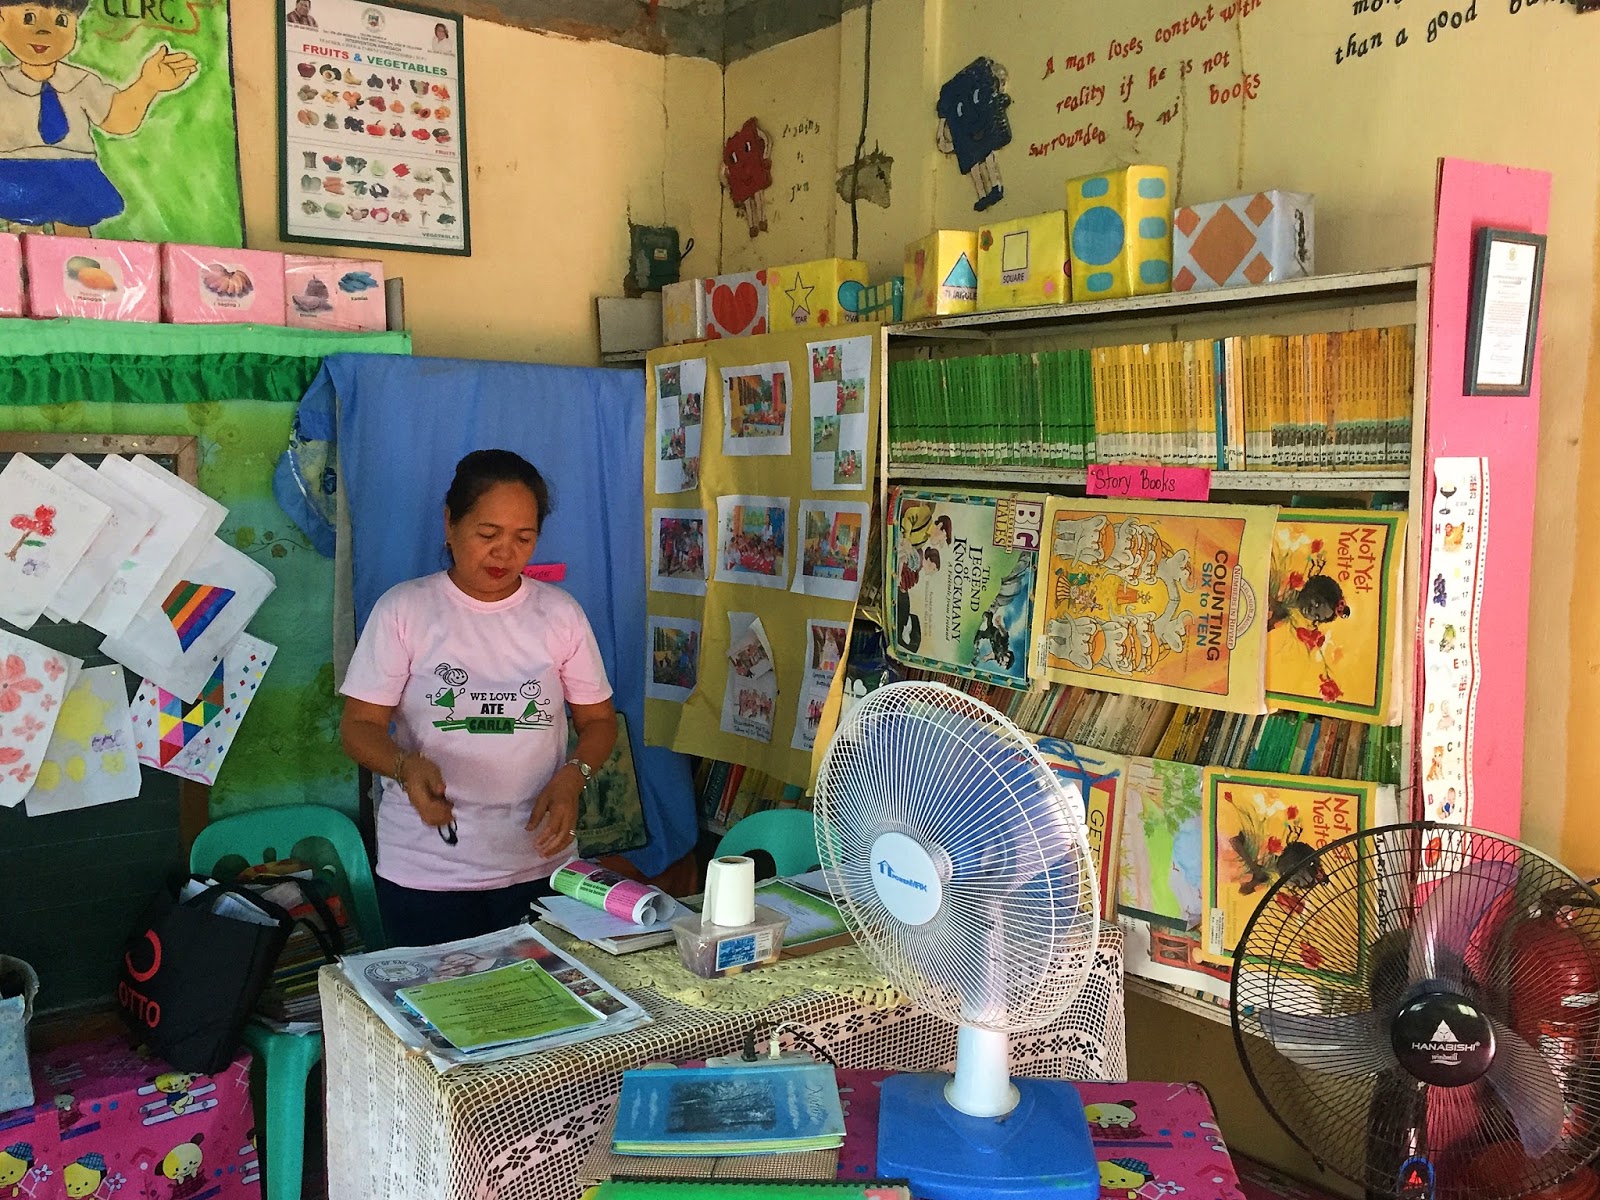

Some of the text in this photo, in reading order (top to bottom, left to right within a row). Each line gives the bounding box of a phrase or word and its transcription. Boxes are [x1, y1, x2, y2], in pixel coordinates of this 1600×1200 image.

[1042, 56, 1055, 80] A
[1065, 51, 1096, 72] man
[1108, 37, 1144, 61] loses
[1155, 3, 1215, 43] contact
[1334, 31, 1383, 65] than
[1395, 27, 1408, 47] a
[1427, 0, 1478, 43] good
[303, 44, 349, 60] FRUITS
[353, 52, 363, 62] &
[367, 55, 448, 76] VEGETABLES
[1056, 50, 1231, 114] reality if he is not
[1209, 73, 1261, 105] books
[945, 289, 978, 301] TIANGLE
[1003, 273, 1025, 283] SQUARE
[794, 314, 808, 324] STAR
[1095, 466, 1176, 495] Story Books
[994, 500, 1009, 544] TALES
[1013, 502, 1042, 548] BIG
[963, 566, 971, 582] of
[1337, 528, 1360, 582] Yvette
[1353, 528, 1377, 594] Not Yet,
[951, 536, 967, 643] KNOCKMANY
[968, 545, 984, 612] LEGEND
[981, 566, 991, 591] The
[1196, 562, 1213, 646] SIX to TEN
[1207, 550, 1228, 661] COUNTING
[1228, 568, 1241, 647] NUMBERS IN RHYME
[470, 692, 517, 702] WE LOVE
[480, 703, 504, 715] ATE
[469, 721, 513, 732] CARLA
[1312, 797, 1331, 849] Yvette
[1333, 798, 1351, 833] Not
[118, 980, 161, 1029] OTTO
[1411, 1042, 1476, 1052] HANABISHI
